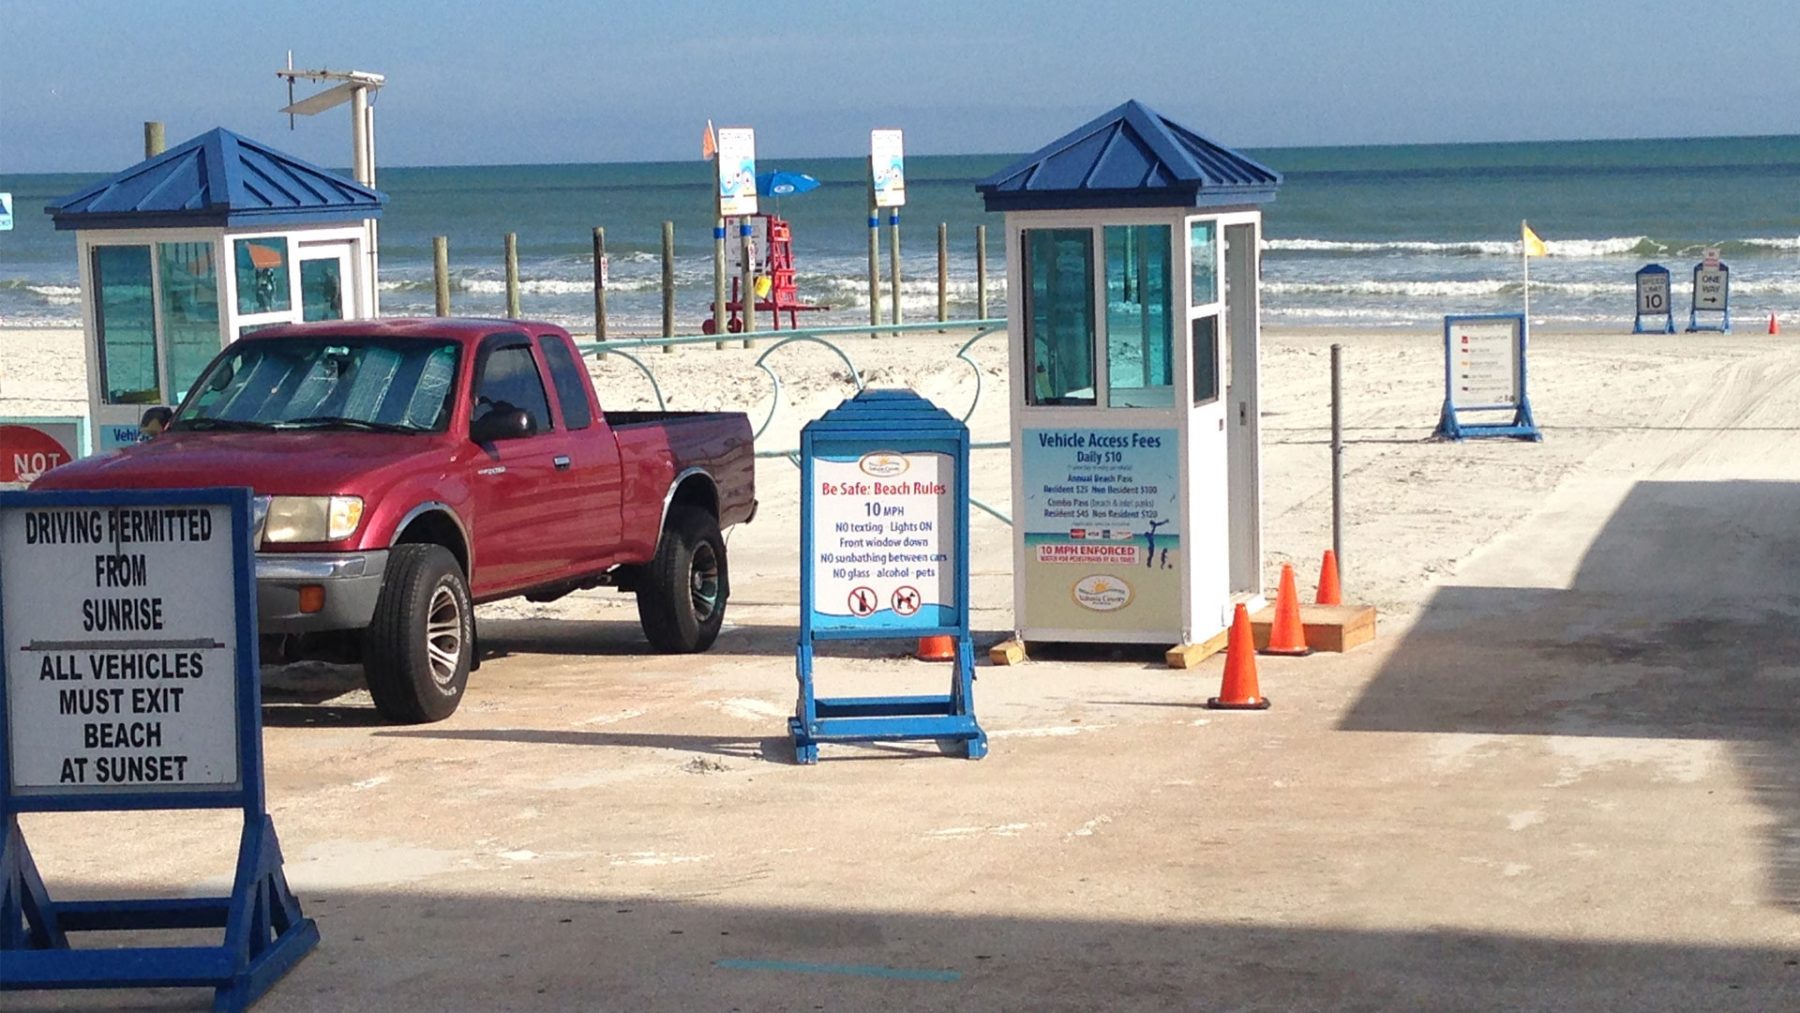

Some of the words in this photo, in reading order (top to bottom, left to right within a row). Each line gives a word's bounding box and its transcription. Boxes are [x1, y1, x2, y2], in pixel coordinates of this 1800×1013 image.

[1702, 275, 1720, 283] ONE
[1645, 294, 1662, 308] 10
[1039, 432, 1085, 448] Vehicle
[1088, 432, 1129, 448] Access
[1132, 433, 1161, 448] Fees
[14, 452, 60, 474] NOT
[1077, 451, 1101, 465] Daily
[1104, 451, 1122, 463] $10
[1068, 474, 1092, 482] Annual
[1094, 474, 1115, 482] Beach
[822, 482, 837, 496] Be
[840, 482, 870, 495] Safe:
[874, 482, 910, 495] Beach
[914, 481, 946, 495] Rules
[1043, 485, 1074, 494] Resident
[1107, 485, 1139, 494] Resident
[864, 502, 881, 516] 10
[883, 506, 904, 516] MPH
[1044, 509, 1075, 518] Resident
[1108, 510, 1139, 518] Resident
[25, 510, 102, 545] DRIVING
[108, 509, 213, 543] PERMITTED
[835, 522, 849, 533] NO
[851, 521, 883, 534] texting
[890, 521, 918, 534] Lights
[919, 521, 932, 532] ON
[840, 538, 863, 548] Front
[866, 537, 901, 547] window
[903, 537, 928, 547] down
[1041, 546, 1052, 554] 10
[1055, 546, 1078, 554] MPH
[1080, 546, 1135, 555] ENFORCED
[820, 553, 834, 563] NO
[836, 552, 886, 565] sunbathing
[888, 552, 928, 563] between
[930, 554, 947, 562] cars
[95, 554, 147, 588] FROM
[833, 568, 846, 578] NO
[848, 568, 870, 580] glass
[876, 567, 909, 578] alcohol
[916, 568, 935, 579] pets
[83, 598, 163, 632] SUNRISE
[40, 655, 82, 680] ALL
[89, 652, 204, 679] VEHICLES
[59, 688, 124, 715] MUST
[132, 688, 184, 713] EXIT
[84, 722, 162, 748] BEACH
[60, 758, 88, 783] AT
[96, 756, 188, 782] SUNSET
